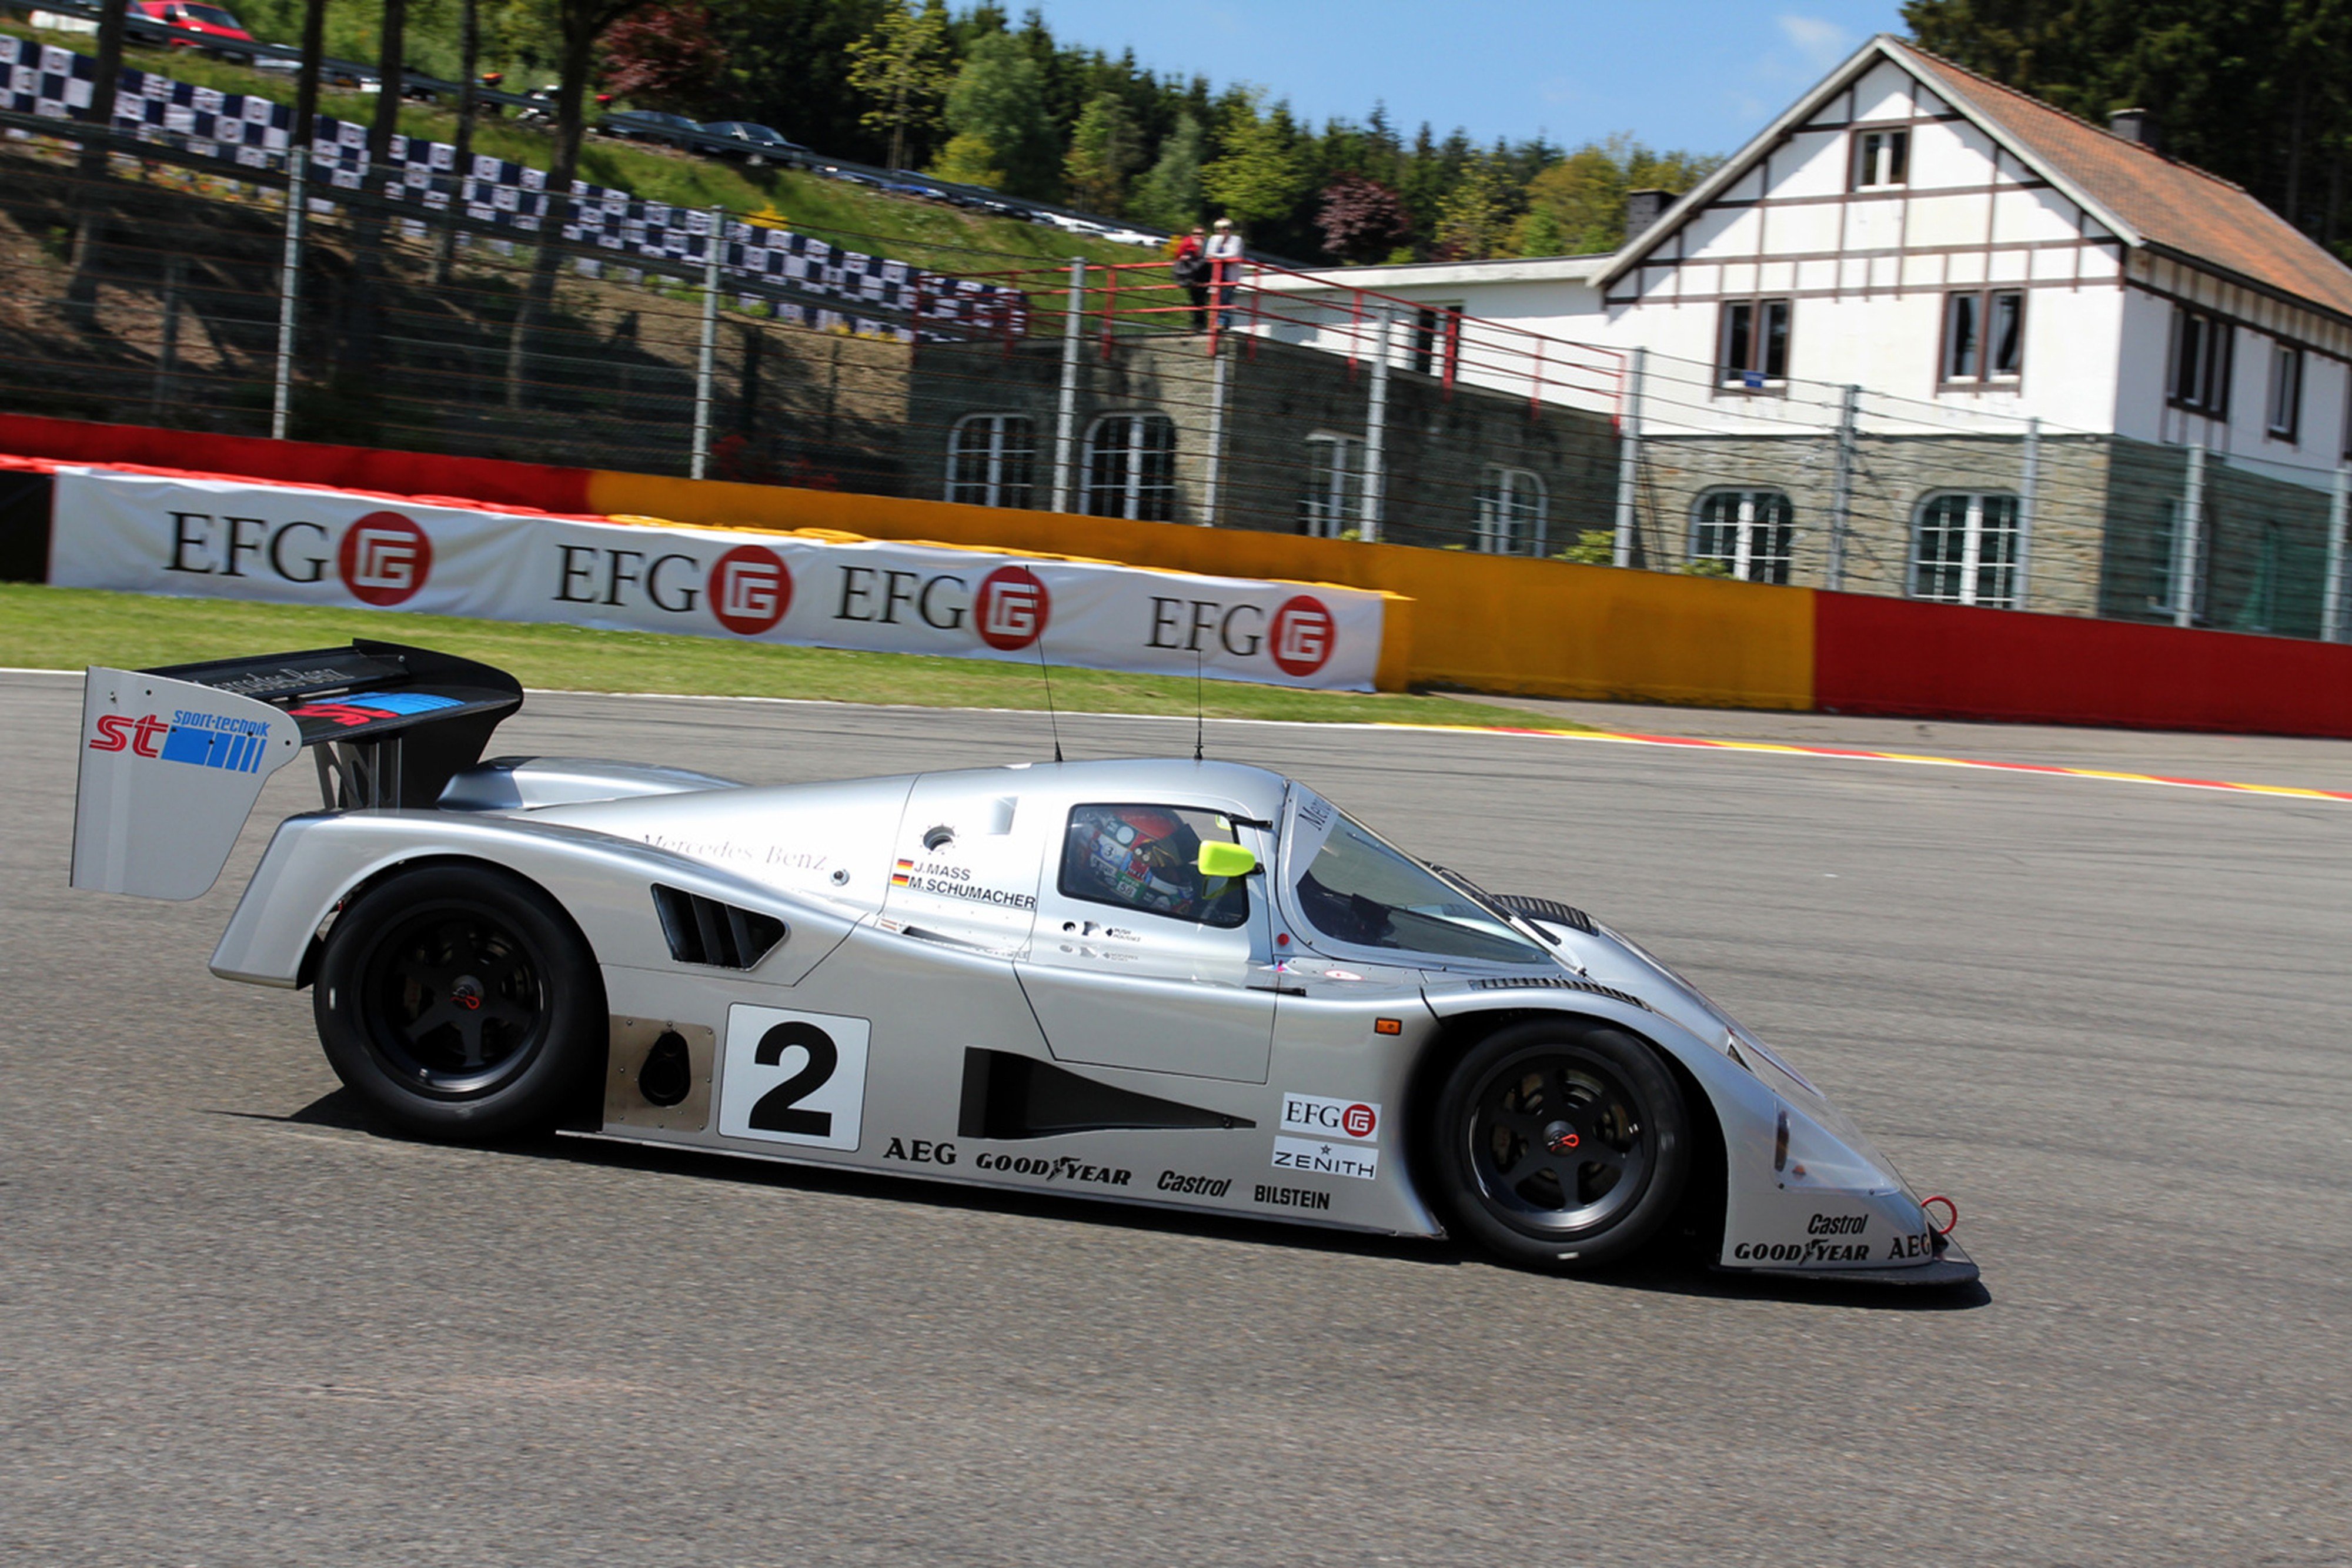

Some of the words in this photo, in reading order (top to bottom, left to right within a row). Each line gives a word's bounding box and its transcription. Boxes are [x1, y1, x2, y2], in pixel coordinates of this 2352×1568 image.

[162, 511, 331, 583] EFG
[553, 543, 700, 613] EFG
[833, 565, 970, 630] EFG
[1145, 596, 1265, 656] EFG
[89, 714, 169, 758] st
[766, 845, 828, 871] Benz
[914, 861, 972, 881] J.MASS
[909, 876, 1037, 910] M.SCHUMACHER
[749, 1021, 838, 1138] 2
[1285, 1100, 1341, 1128] EFG
[883, 1136, 957, 1165] AEG
[1274, 1151, 1375, 1178] ZENITH
[1157, 1170, 1232, 1198] Castrol
[1254, 1184, 1331, 1210] BILSTEIN
[1808, 1213, 1869, 1235] Castrol
[1887, 1233, 1931, 1261] AEG
